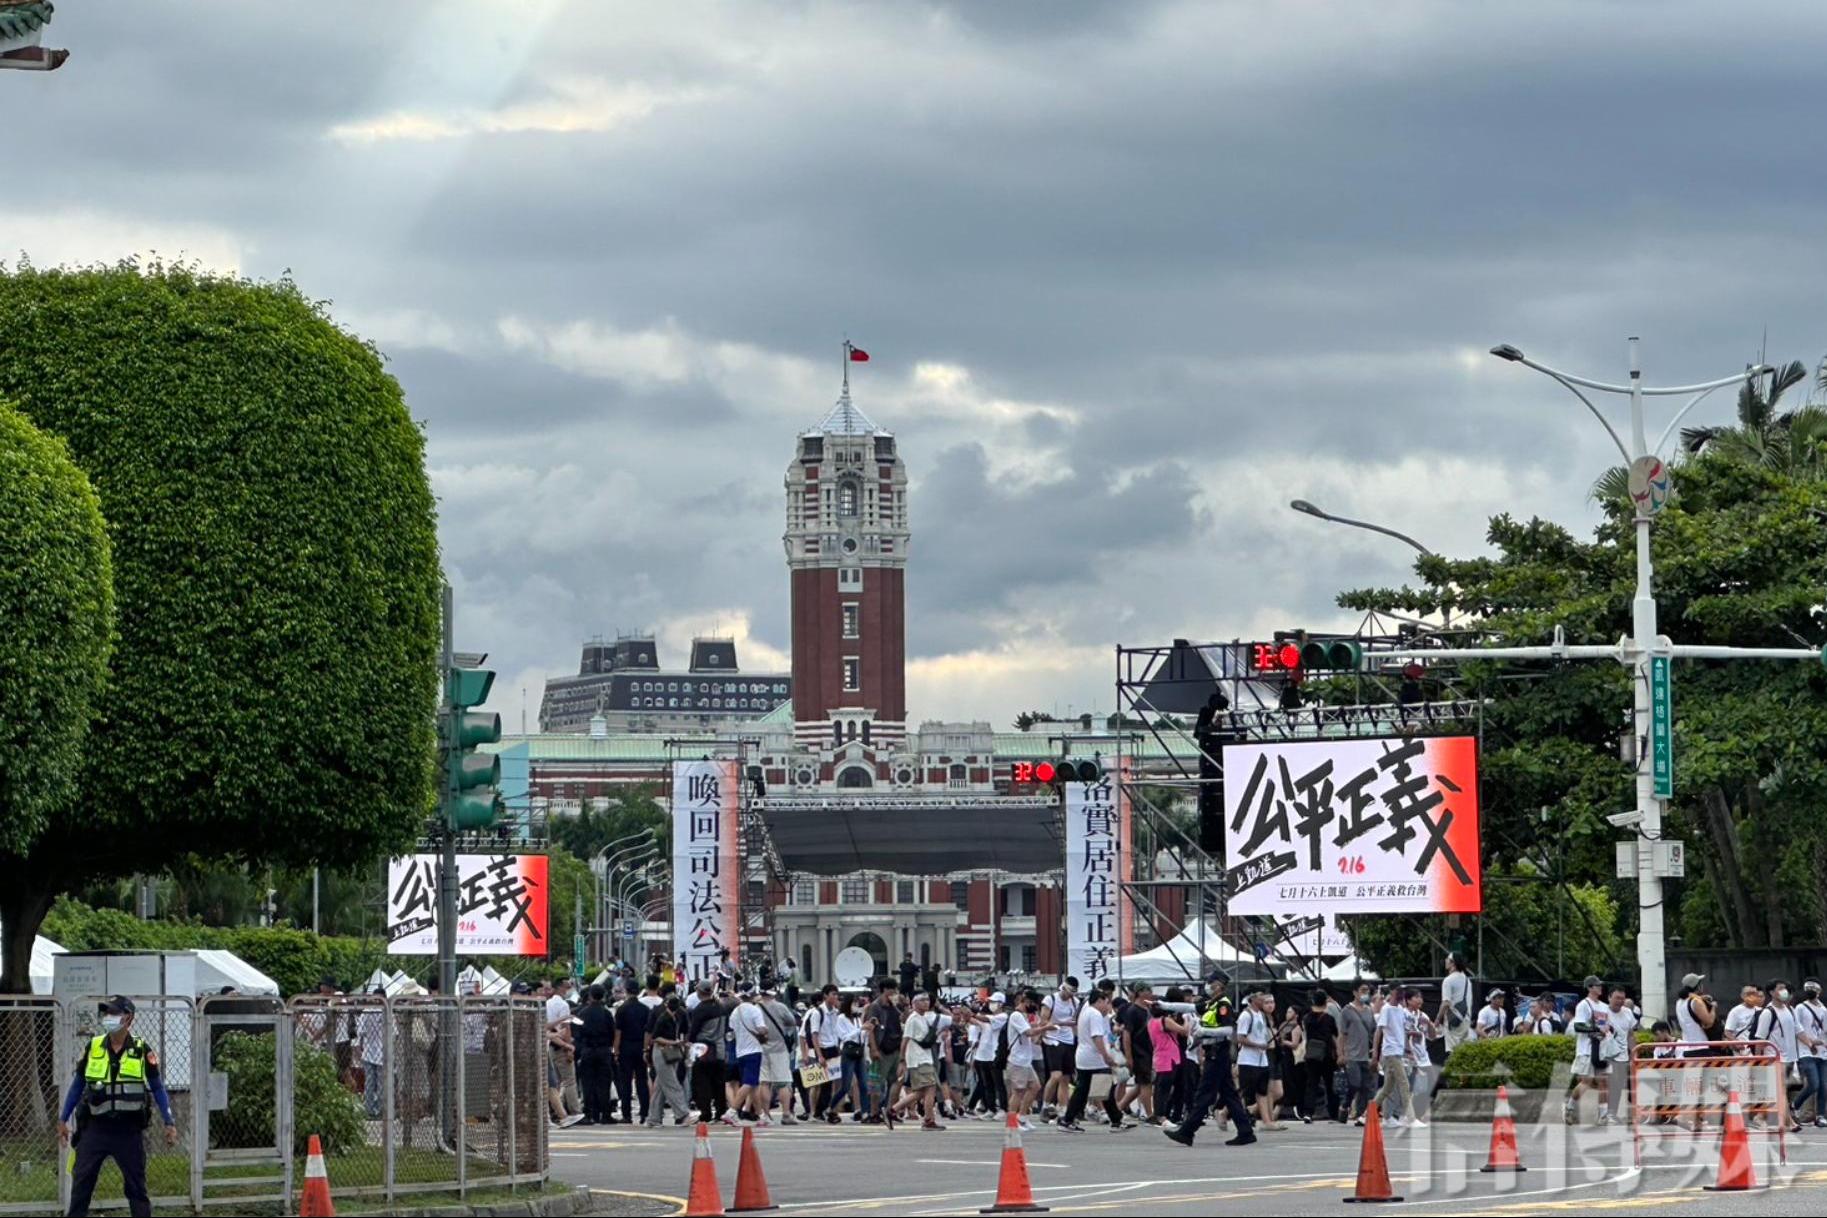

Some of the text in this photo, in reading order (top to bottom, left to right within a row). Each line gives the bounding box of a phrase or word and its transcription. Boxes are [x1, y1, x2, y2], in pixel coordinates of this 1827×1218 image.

[1014, 762, 1032, 781] 32
[1230, 738, 1473, 886] 公平正義
[392, 856, 542, 939] 公正義
[1280, 885, 1427, 899] 七月十六上凱道 公平正義救台灣
